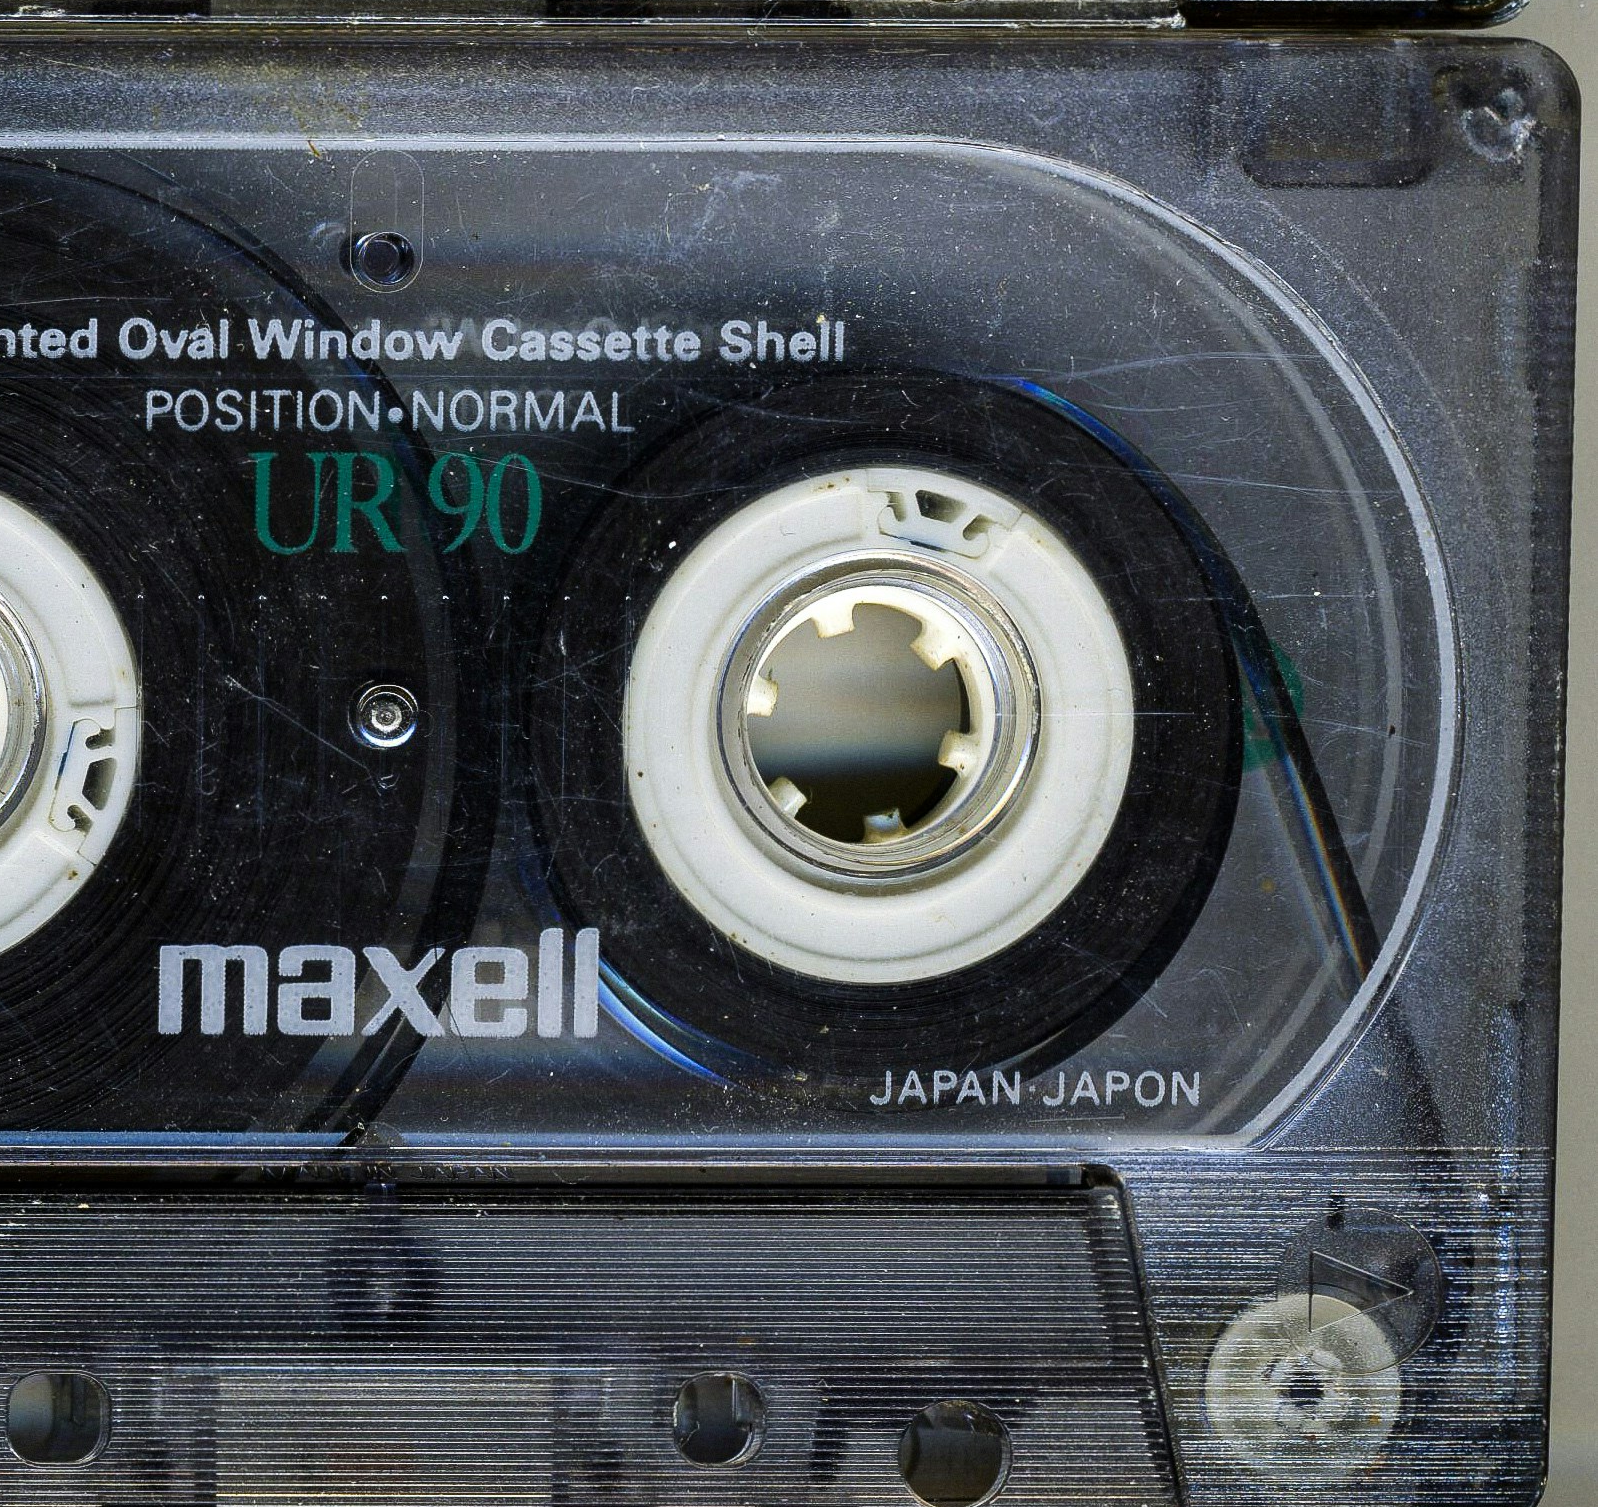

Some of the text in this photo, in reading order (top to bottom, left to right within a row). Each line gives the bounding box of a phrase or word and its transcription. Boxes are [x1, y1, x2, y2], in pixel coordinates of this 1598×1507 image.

[118, 316, 233, 361] Oval
[247, 316, 460, 361] Window
[481, 316, 704, 361] Cassette
[717, 319, 847, 362] Shell
[157, 927, 599, 1039] maxell
